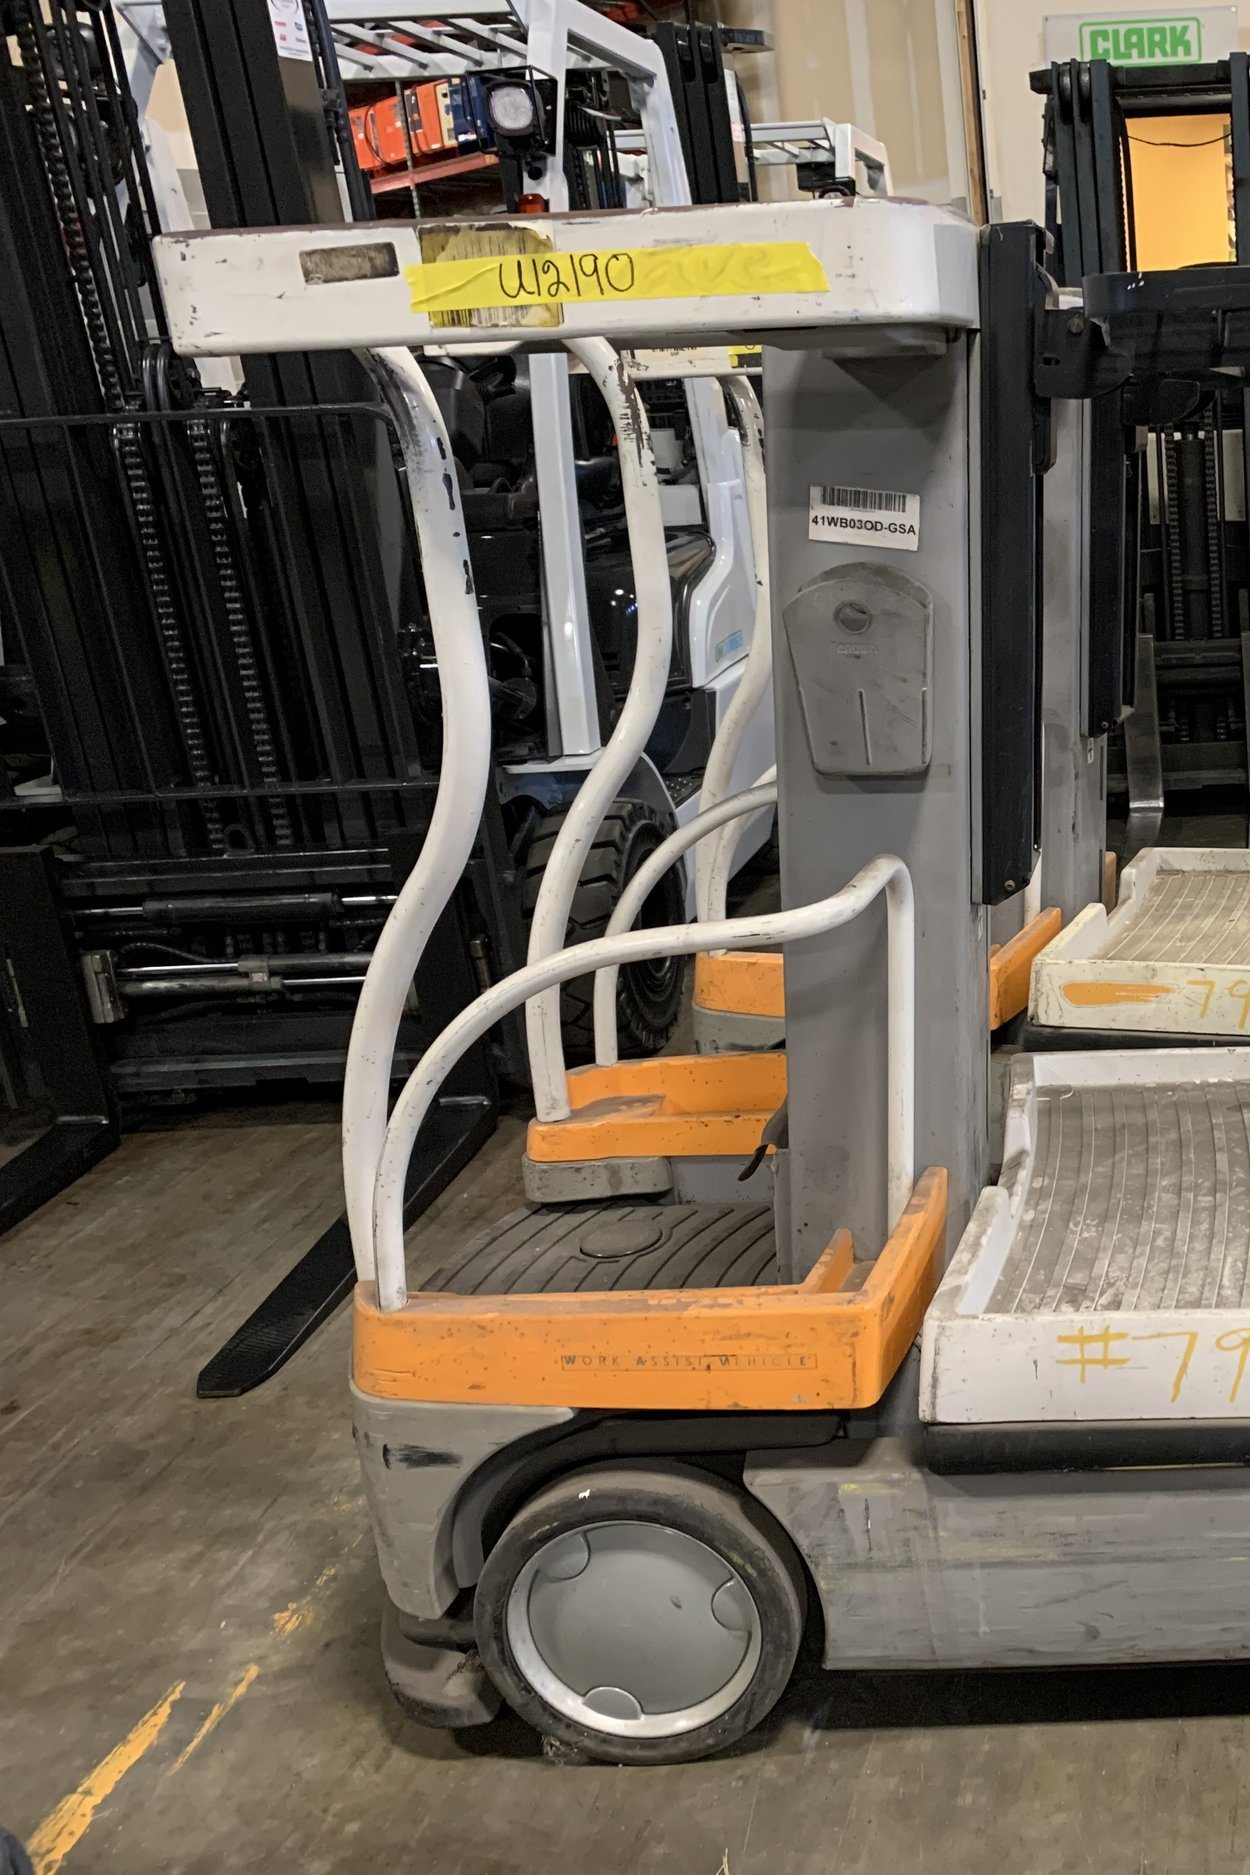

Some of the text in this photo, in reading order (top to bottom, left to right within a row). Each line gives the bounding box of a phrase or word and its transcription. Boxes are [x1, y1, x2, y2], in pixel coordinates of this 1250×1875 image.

[1089, 25, 1192, 60] CLARK
[563, 1355, 620, 1367] WORK
[635, 1355, 703, 1367] ASSIST
